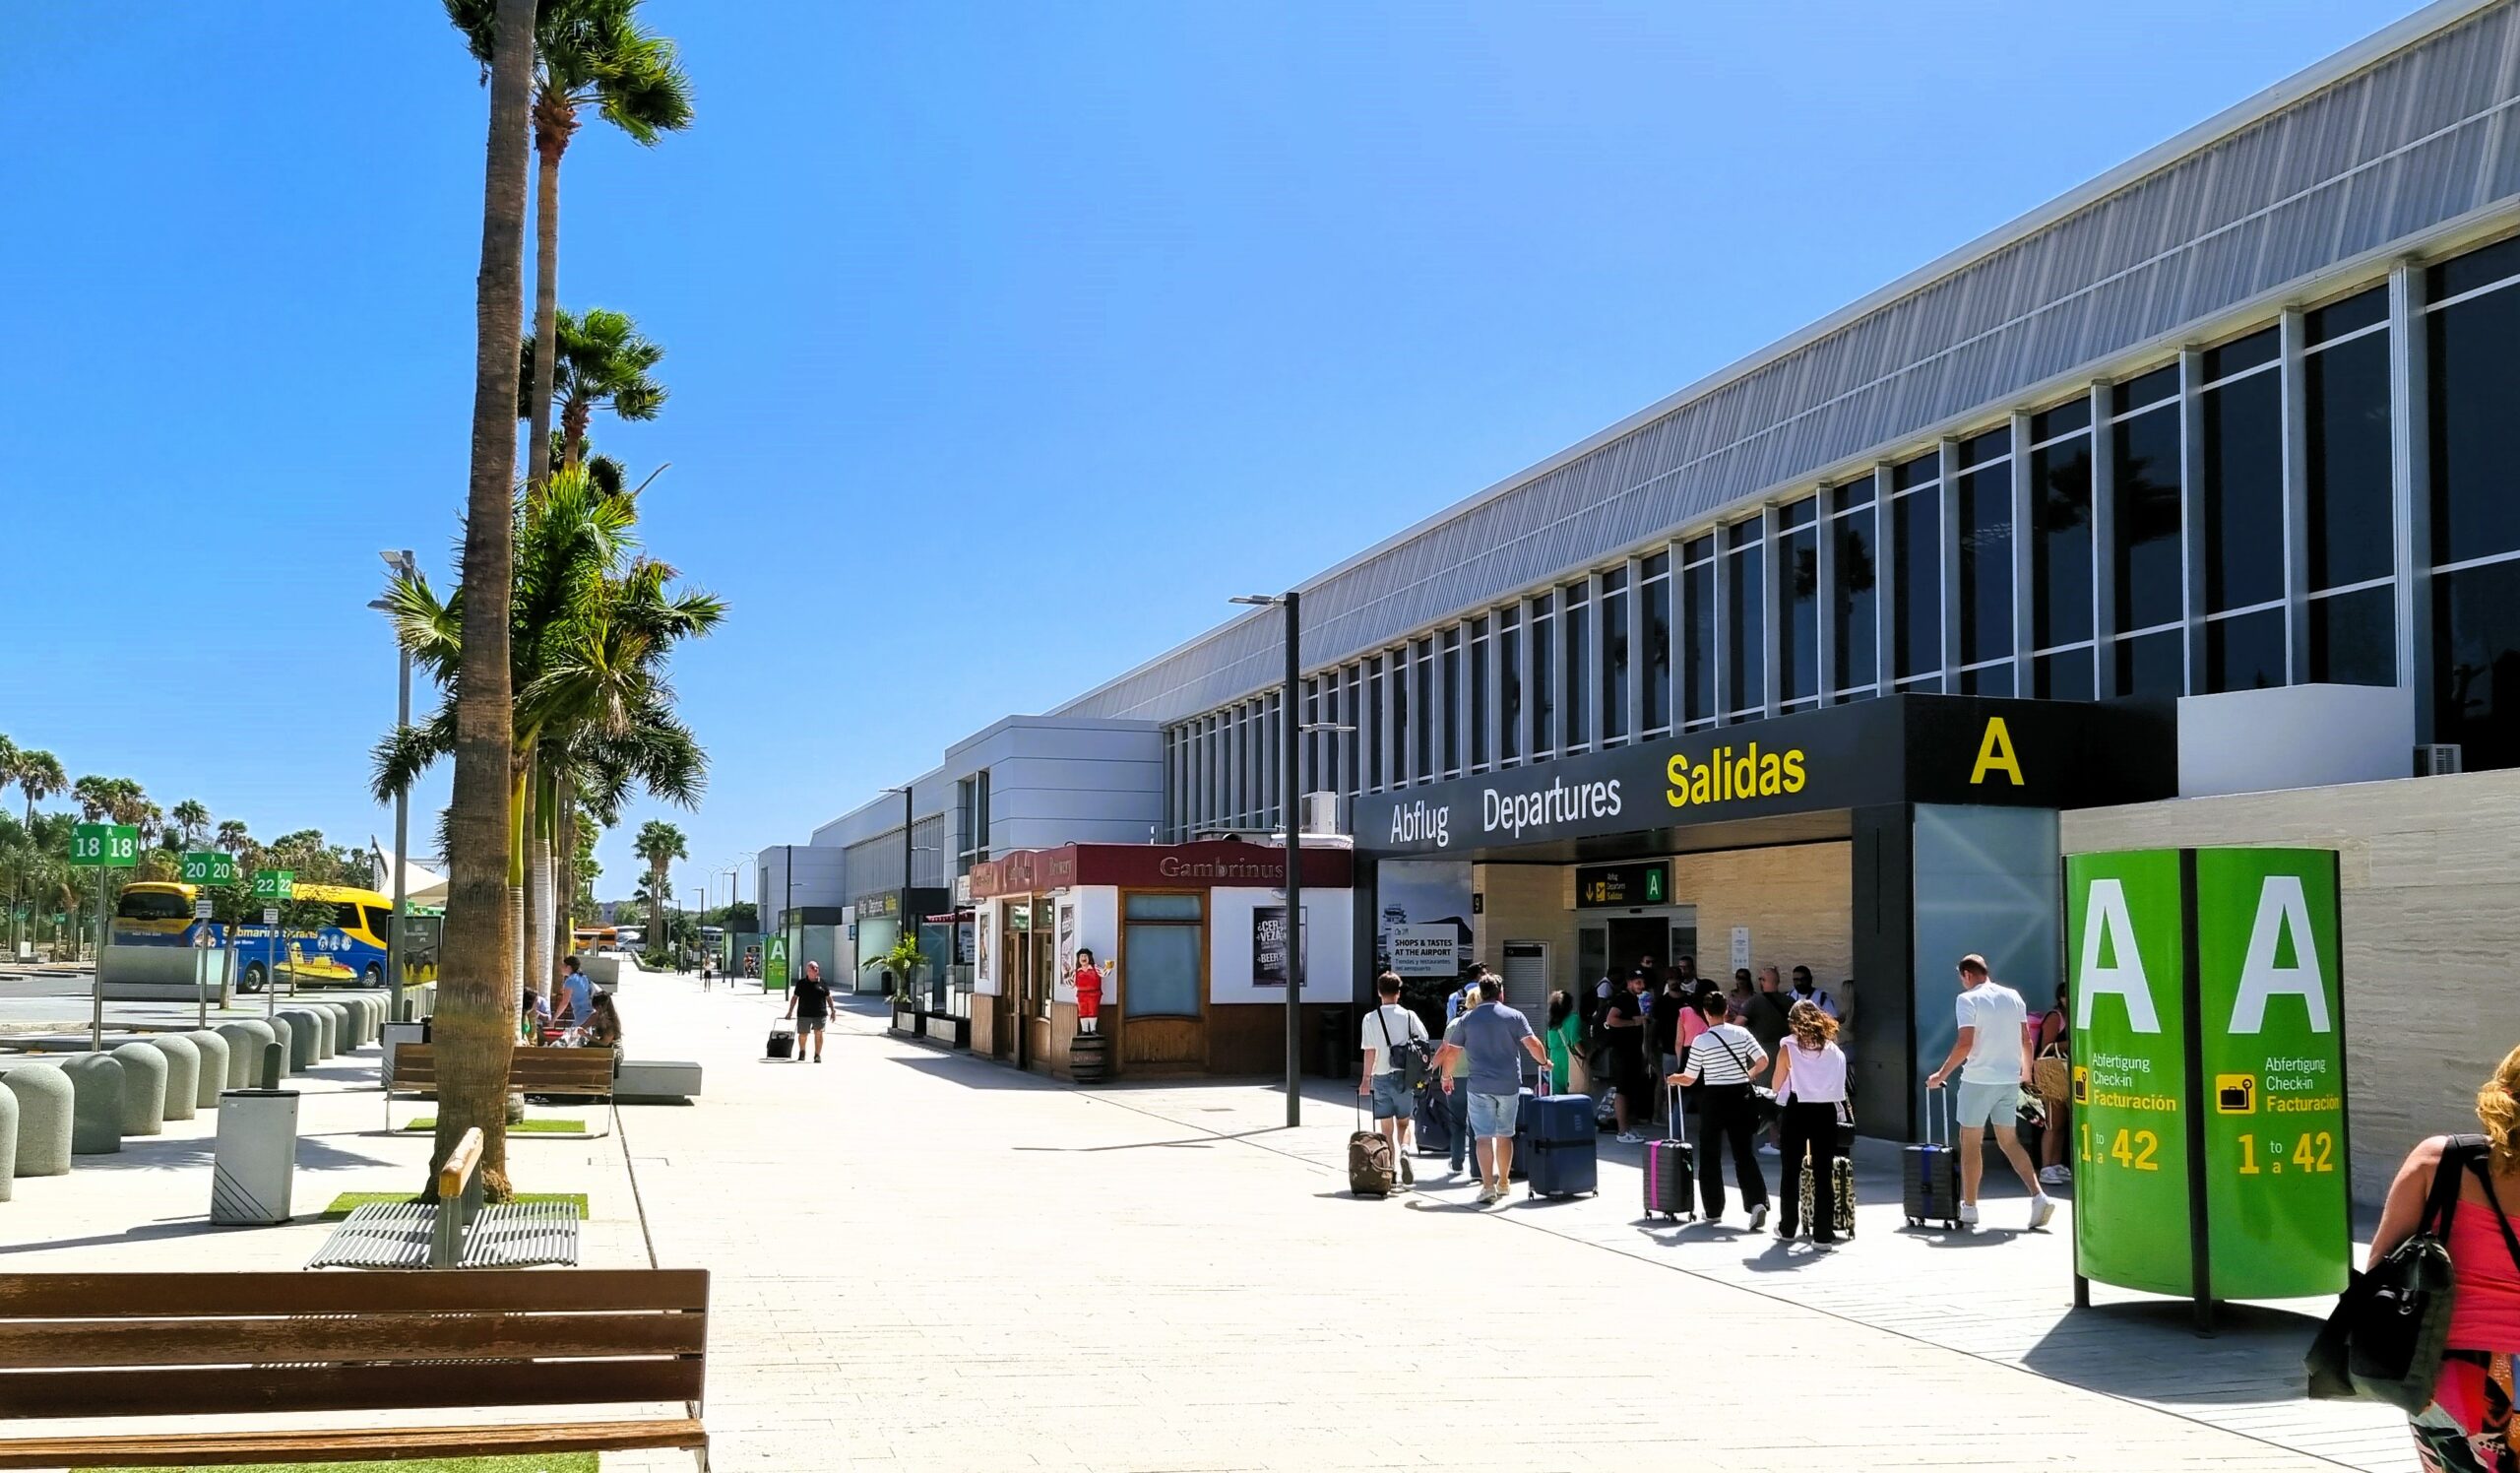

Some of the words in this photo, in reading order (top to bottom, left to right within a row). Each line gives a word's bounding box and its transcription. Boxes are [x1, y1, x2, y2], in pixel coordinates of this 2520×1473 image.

[1970, 717, 2024, 785] A
[1390, 800, 1449, 848] Abflug
[1483, 775, 1622, 838] Departures
[1667, 742, 1806, 808] Salidas
[77, 837, 99, 857] 18
[110, 838, 132, 859] 18
[186, 863, 207, 878] 20
[213, 864, 229, 878] 20
[1160, 856, 1284, 878] Gambrinus
[257, 879, 276, 892] 22
[280, 879, 291, 892] 22
[1650, 875, 1658, 895] A
[1475, 898, 1480, 911] 9
[222, 926, 280, 938] Sbmarie
[770, 939, 787, 960] A
[2076, 878, 2162, 1033] A
[2228, 875, 2331, 1034] A
[2092, 1053, 2150, 1073] Abfertigung
[2265, 1057, 2326, 1074] Abfertigung
[2093, 1070, 2132, 1087] Check-in
[2266, 1075, 2313, 1091] Check-in
[2094, 1089, 2176, 1112] Facturación
[2266, 1094, 2339, 1113] Facturación
[2081, 1123, 2092, 1162] 1
[2096, 1132, 2105, 1145] to
[2269, 1140, 2283, 1154] to
[2097, 1151, 2104, 1164] a
[2111, 1128, 2159, 1171] 42
[2238, 1133, 2260, 1174] 1
[2293, 1131, 2333, 1173] 42
[2272, 1162, 2282, 1174] a
